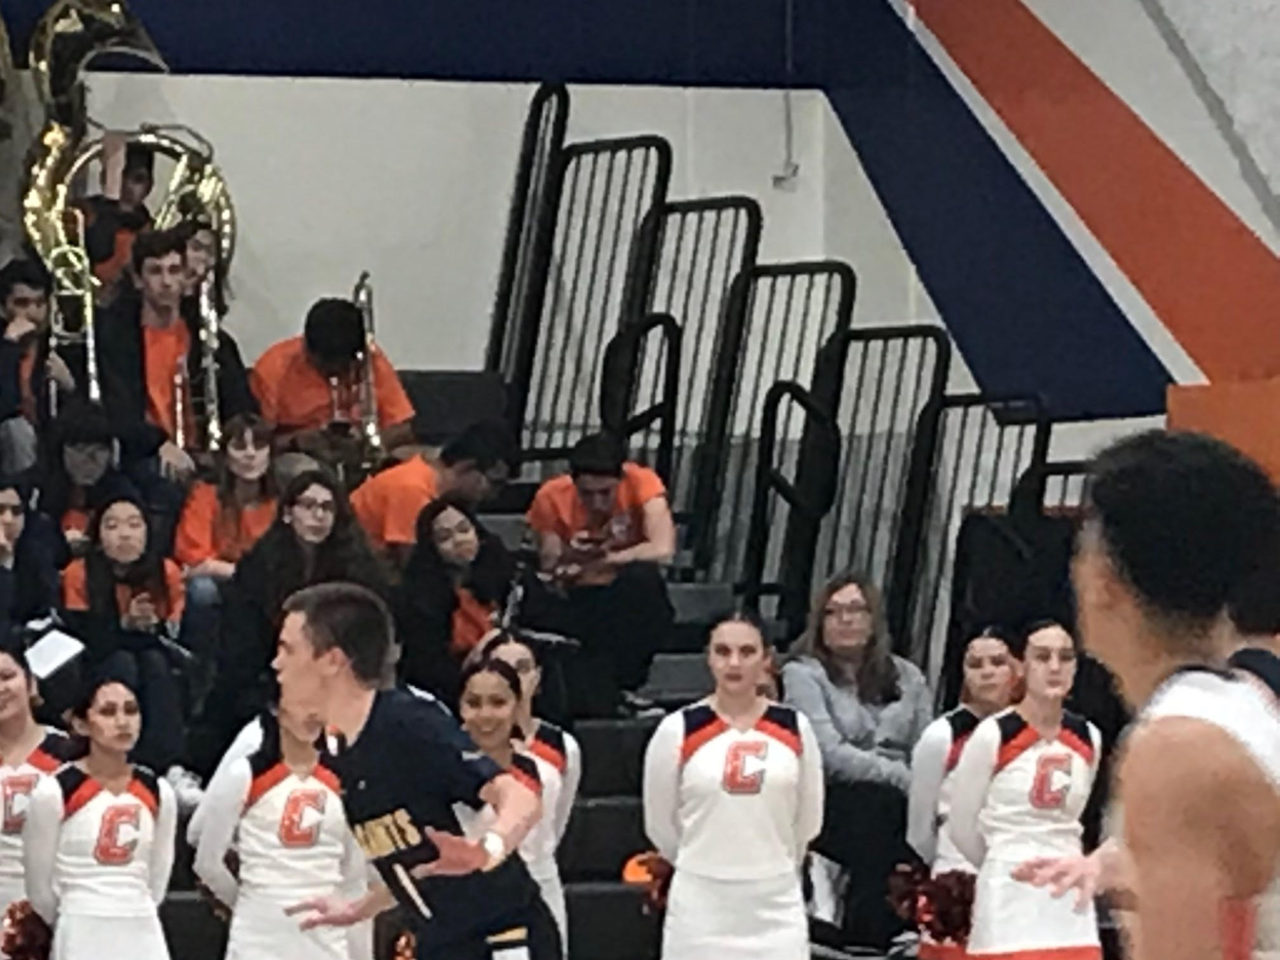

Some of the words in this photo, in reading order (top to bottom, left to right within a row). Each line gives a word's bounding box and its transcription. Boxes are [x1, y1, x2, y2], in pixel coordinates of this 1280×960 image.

[722, 740, 768, 794] C
[1028, 753, 1072, 809] C
[94, 803, 142, 865] C
[277, 788, 327, 849] C
